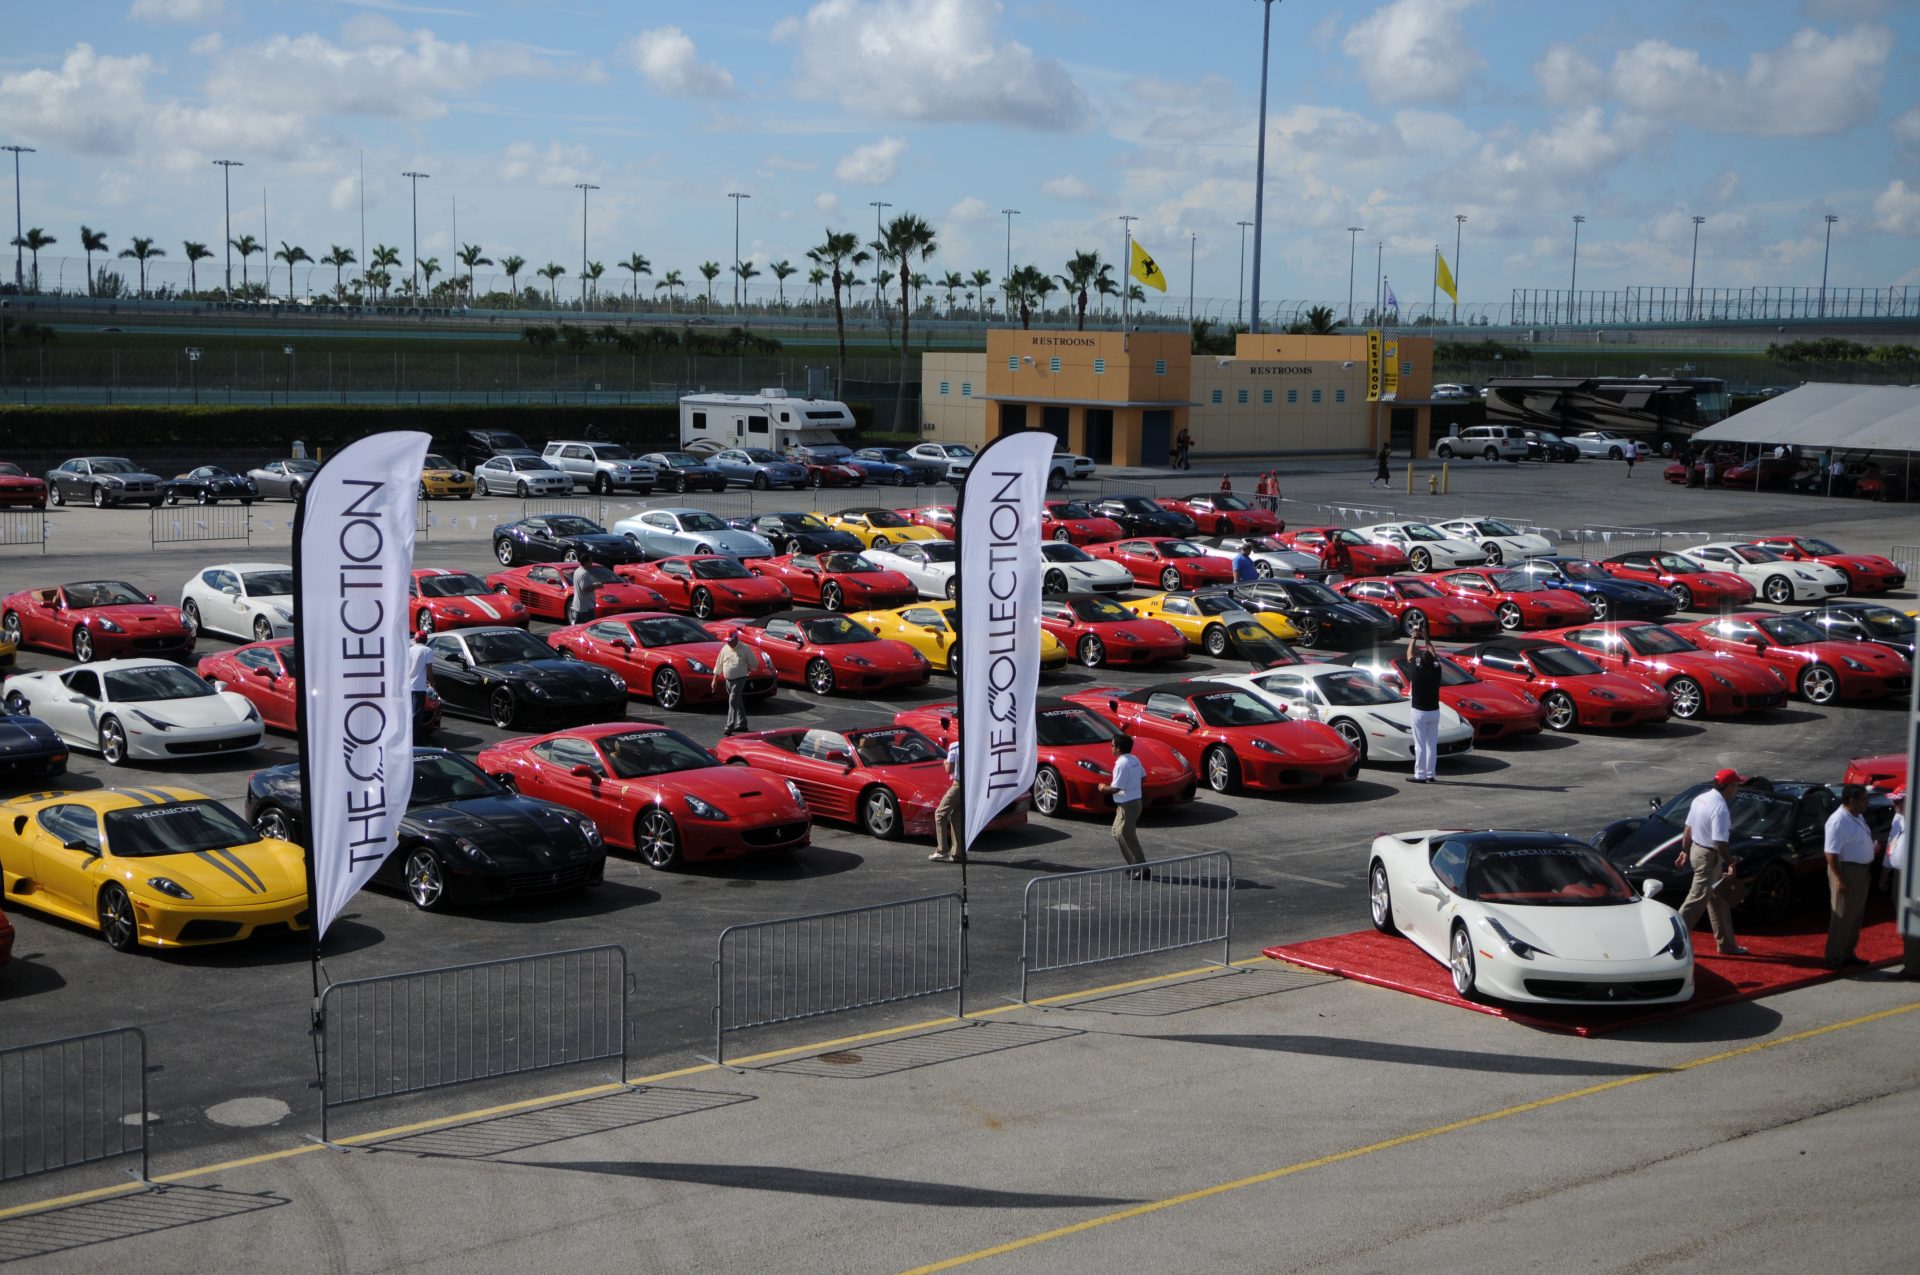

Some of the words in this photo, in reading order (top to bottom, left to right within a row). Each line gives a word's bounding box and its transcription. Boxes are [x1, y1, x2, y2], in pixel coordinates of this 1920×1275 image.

[1032, 337, 1095, 347] RESTROOMS
[1250, 366, 1313, 375] RESTROOMS
[1370, 336, 1379, 398] RESTROOM
[340, 480, 386, 783] COLLECTION
[988, 472, 1023, 725] COLLECTION
[987, 727, 1018, 798] THE
[347, 786, 387, 873] THE
